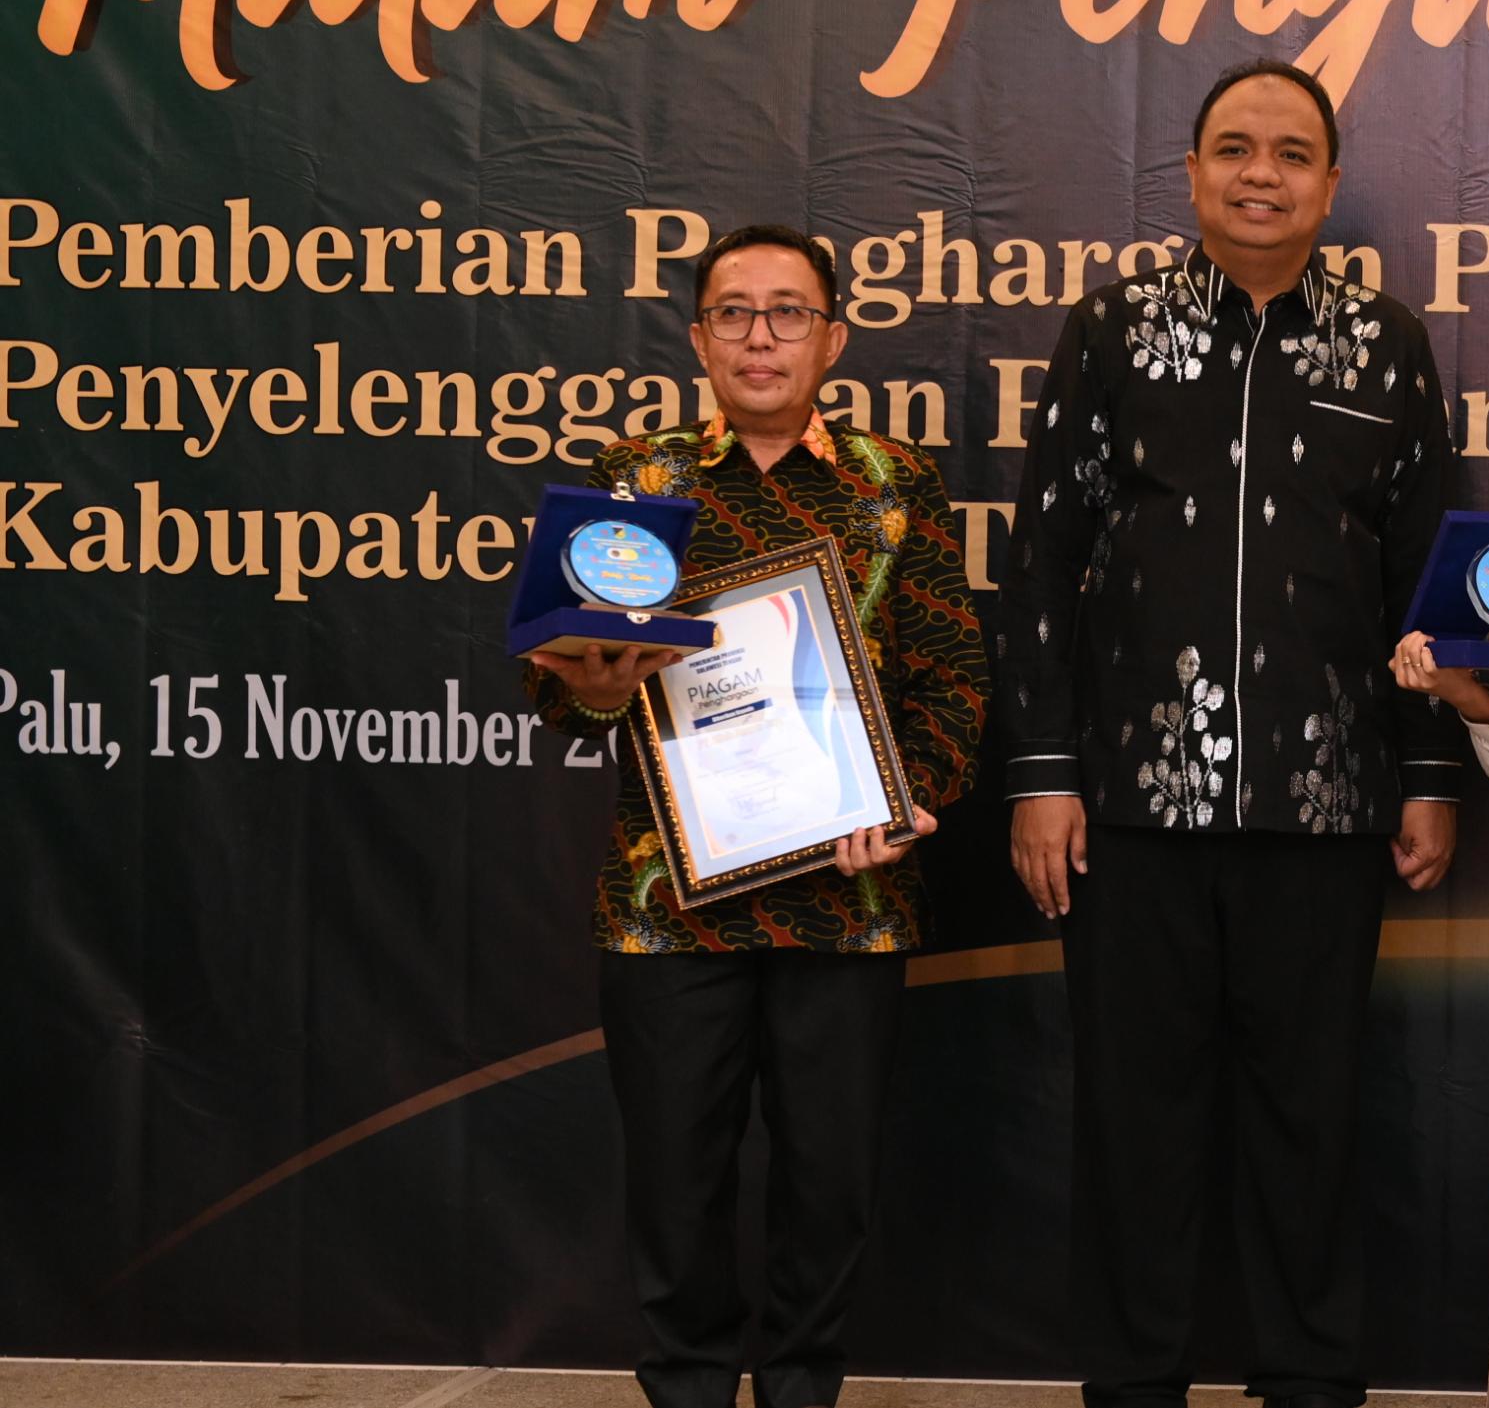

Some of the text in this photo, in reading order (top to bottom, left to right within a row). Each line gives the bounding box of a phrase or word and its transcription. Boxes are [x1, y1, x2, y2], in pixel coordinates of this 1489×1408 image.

[0, 196, 588, 298] Pemberian
[0, 480, 537, 603] Kabupate
[149, 673, 222, 759] 15
[244, 673, 544, 768] November
[687, 667, 763, 703] PIAGAM
